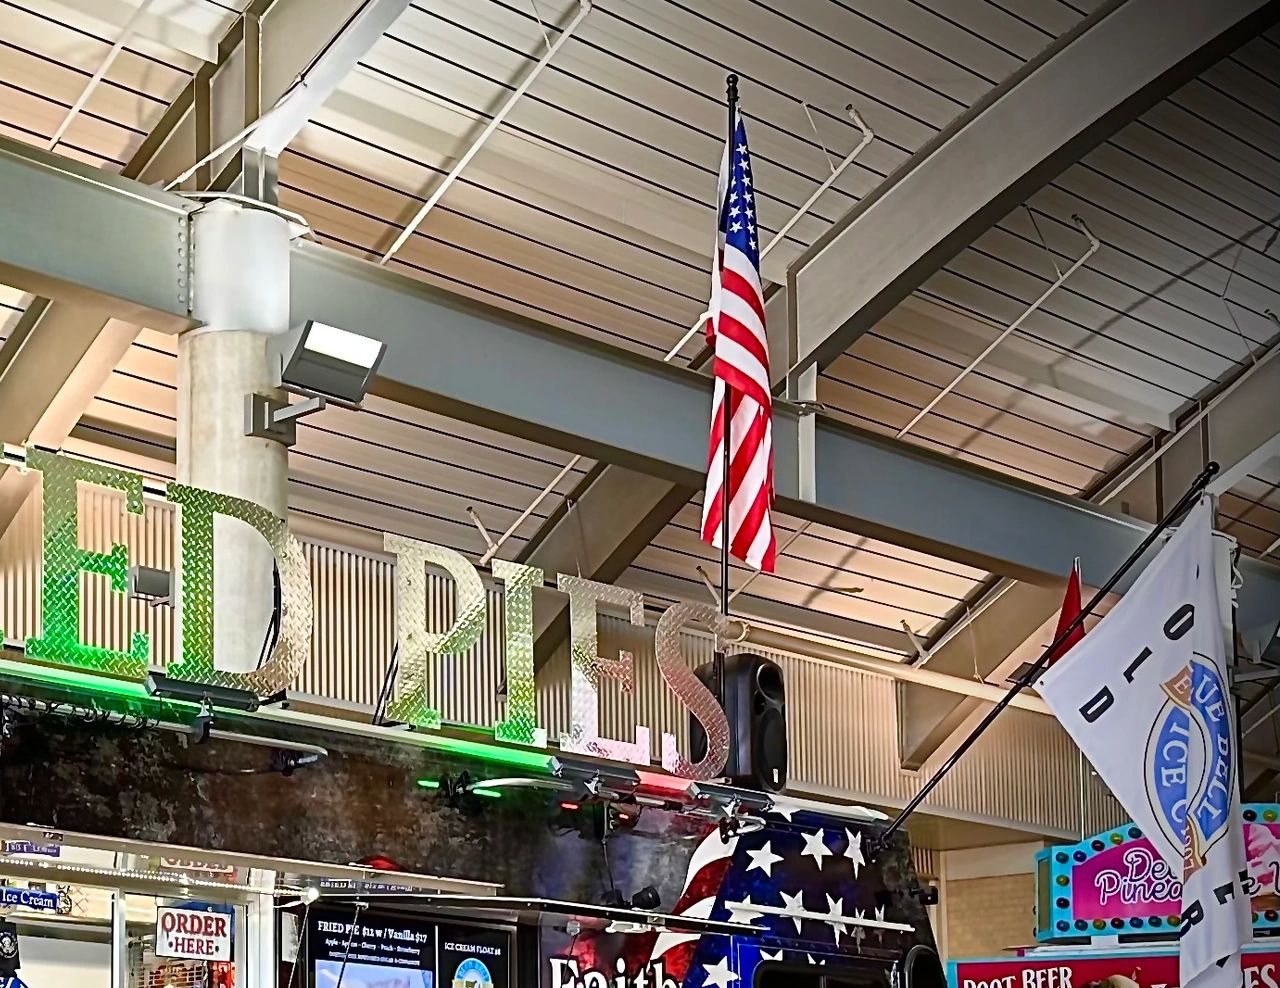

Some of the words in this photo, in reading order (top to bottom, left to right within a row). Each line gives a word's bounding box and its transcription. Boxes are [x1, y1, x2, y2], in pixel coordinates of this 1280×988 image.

[383, 531, 730, 780] PIES
[1161, 721, 1191, 788] ICE
[1, 889, 19, 903] Ice
[20, 890, 55, 909] Cream
[160, 911, 227, 938] ORDER
[317, 920, 345, 934] FRIED
[415, 931, 428, 944] $17
[173, 936, 216, 957] HERE
[455, 943, 476, 953] CREAM
[476, 945, 495, 955] FLOAT
